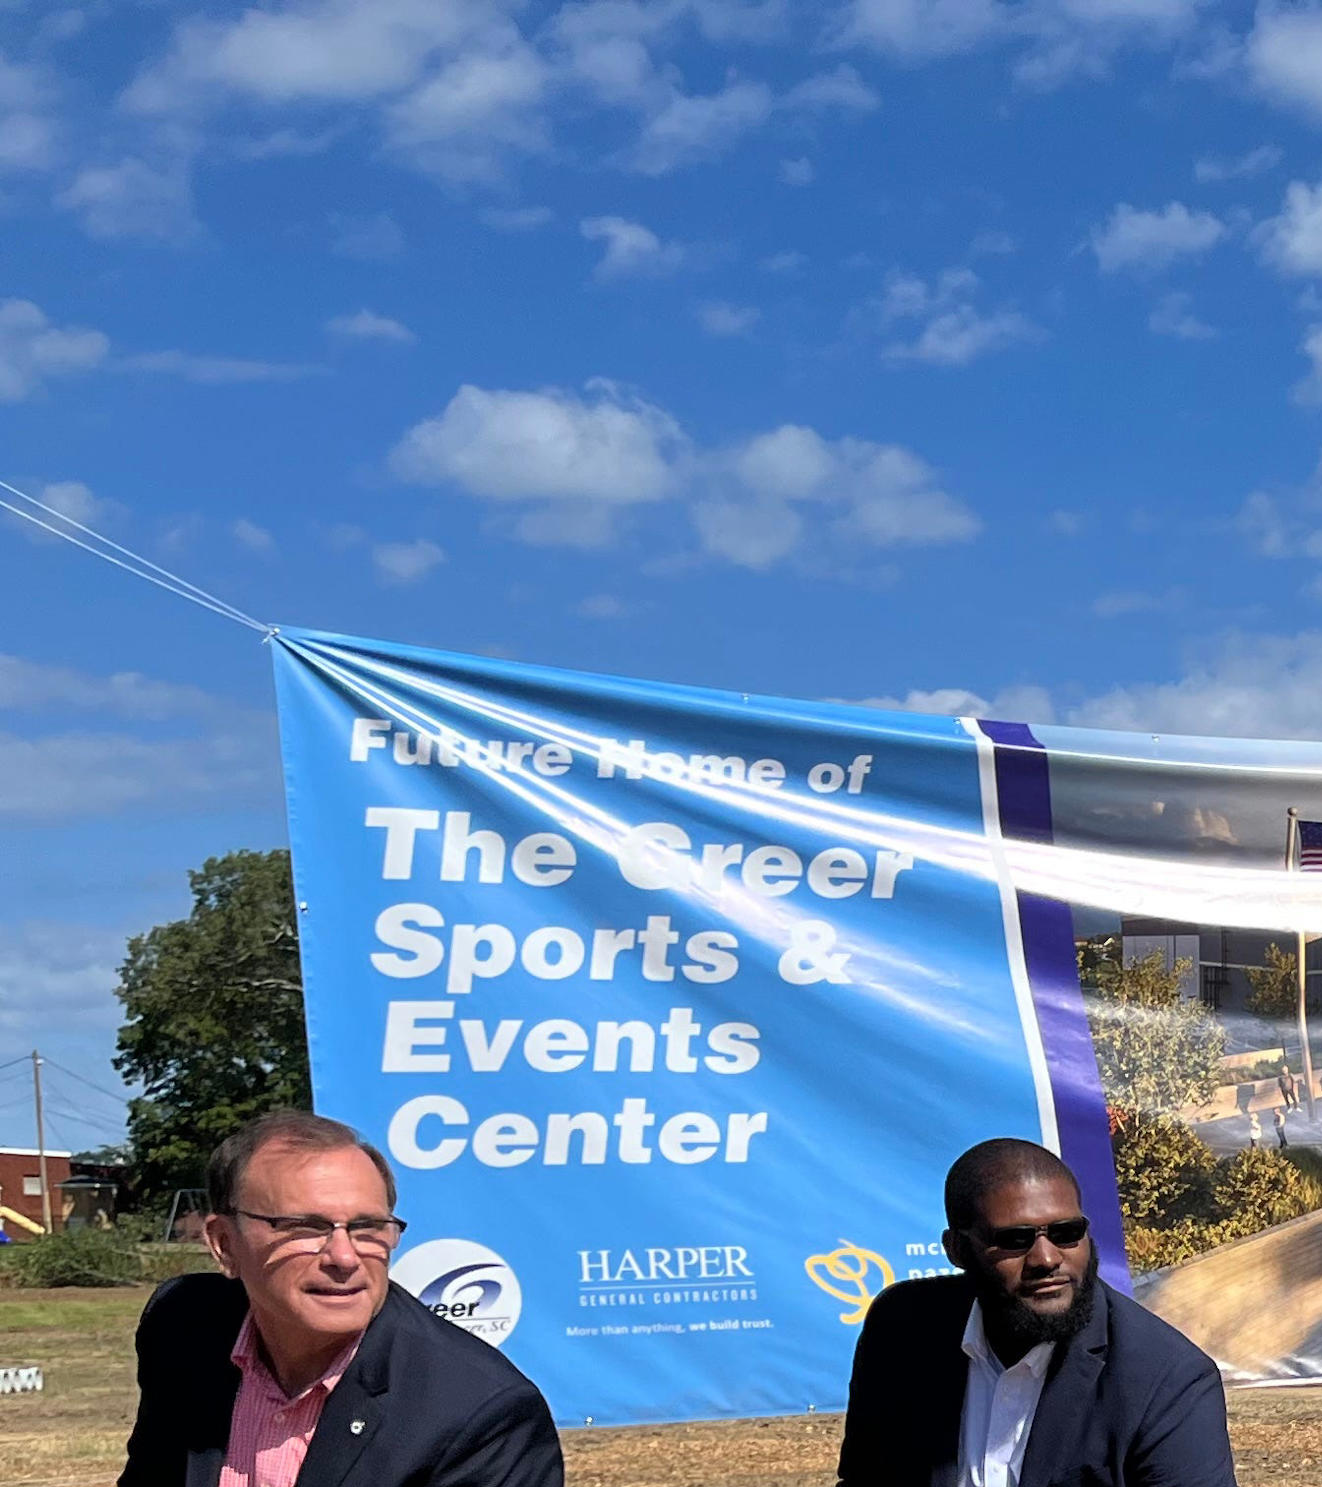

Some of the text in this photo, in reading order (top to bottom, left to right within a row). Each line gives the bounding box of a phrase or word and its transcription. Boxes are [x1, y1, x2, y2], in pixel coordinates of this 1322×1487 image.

[350, 718, 872, 794] Future Home of
[364, 807, 914, 899] The Greer
[370, 903, 852, 994] Sports &
[381, 1001, 761, 1075] Events
[388, 1095, 769, 1170] Center
[577, 1246, 754, 1282] HARPER
[580, 1289, 757, 1307] GENERAL CONTRACTORS
[566, 1318, 774, 1336] More than anything, we build trust.
